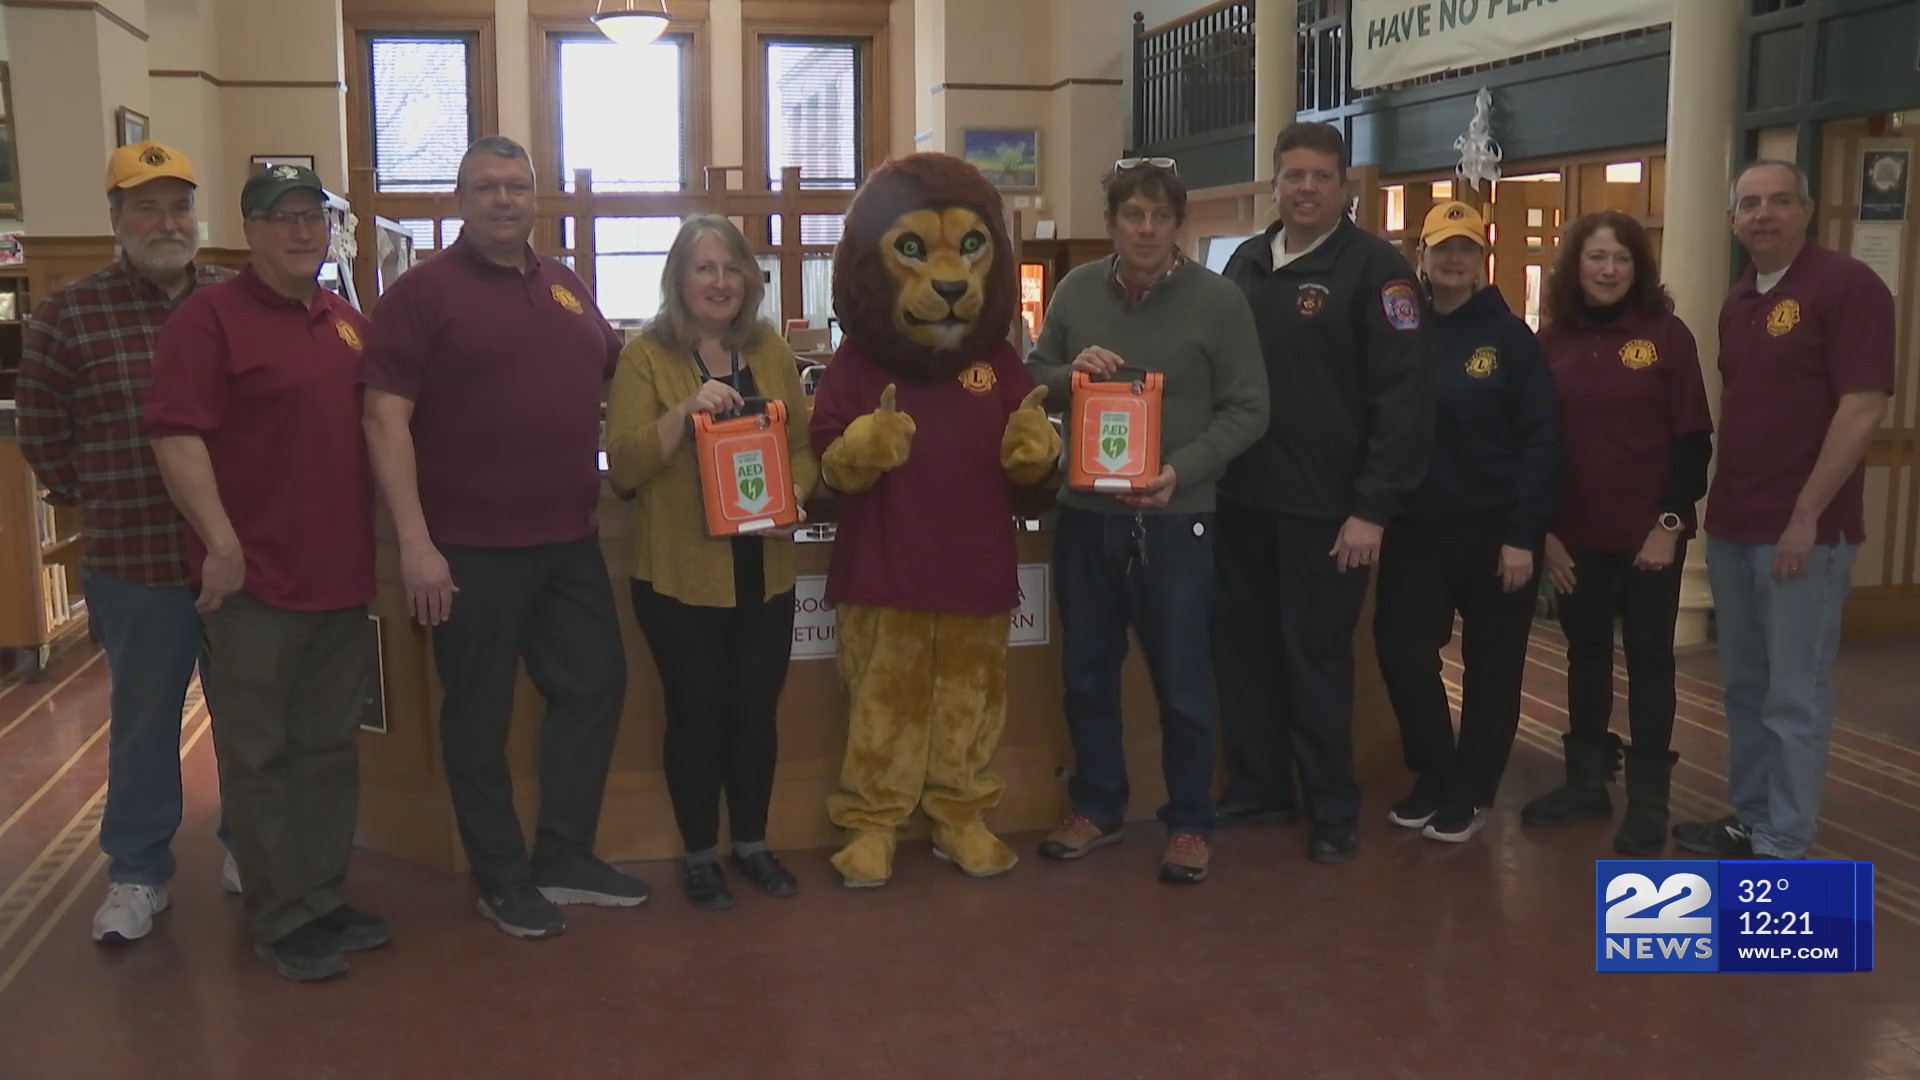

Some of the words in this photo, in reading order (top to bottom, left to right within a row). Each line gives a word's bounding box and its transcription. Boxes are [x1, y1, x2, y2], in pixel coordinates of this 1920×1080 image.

[1368, 4, 1431, 50] HAVE
[1438, 0, 1479, 32] NO
[1488, 0, 1560, 19] PL
[974, 370, 983, 383] L
[1102, 424, 1128, 436] AED
[737, 464, 763, 478] AED
